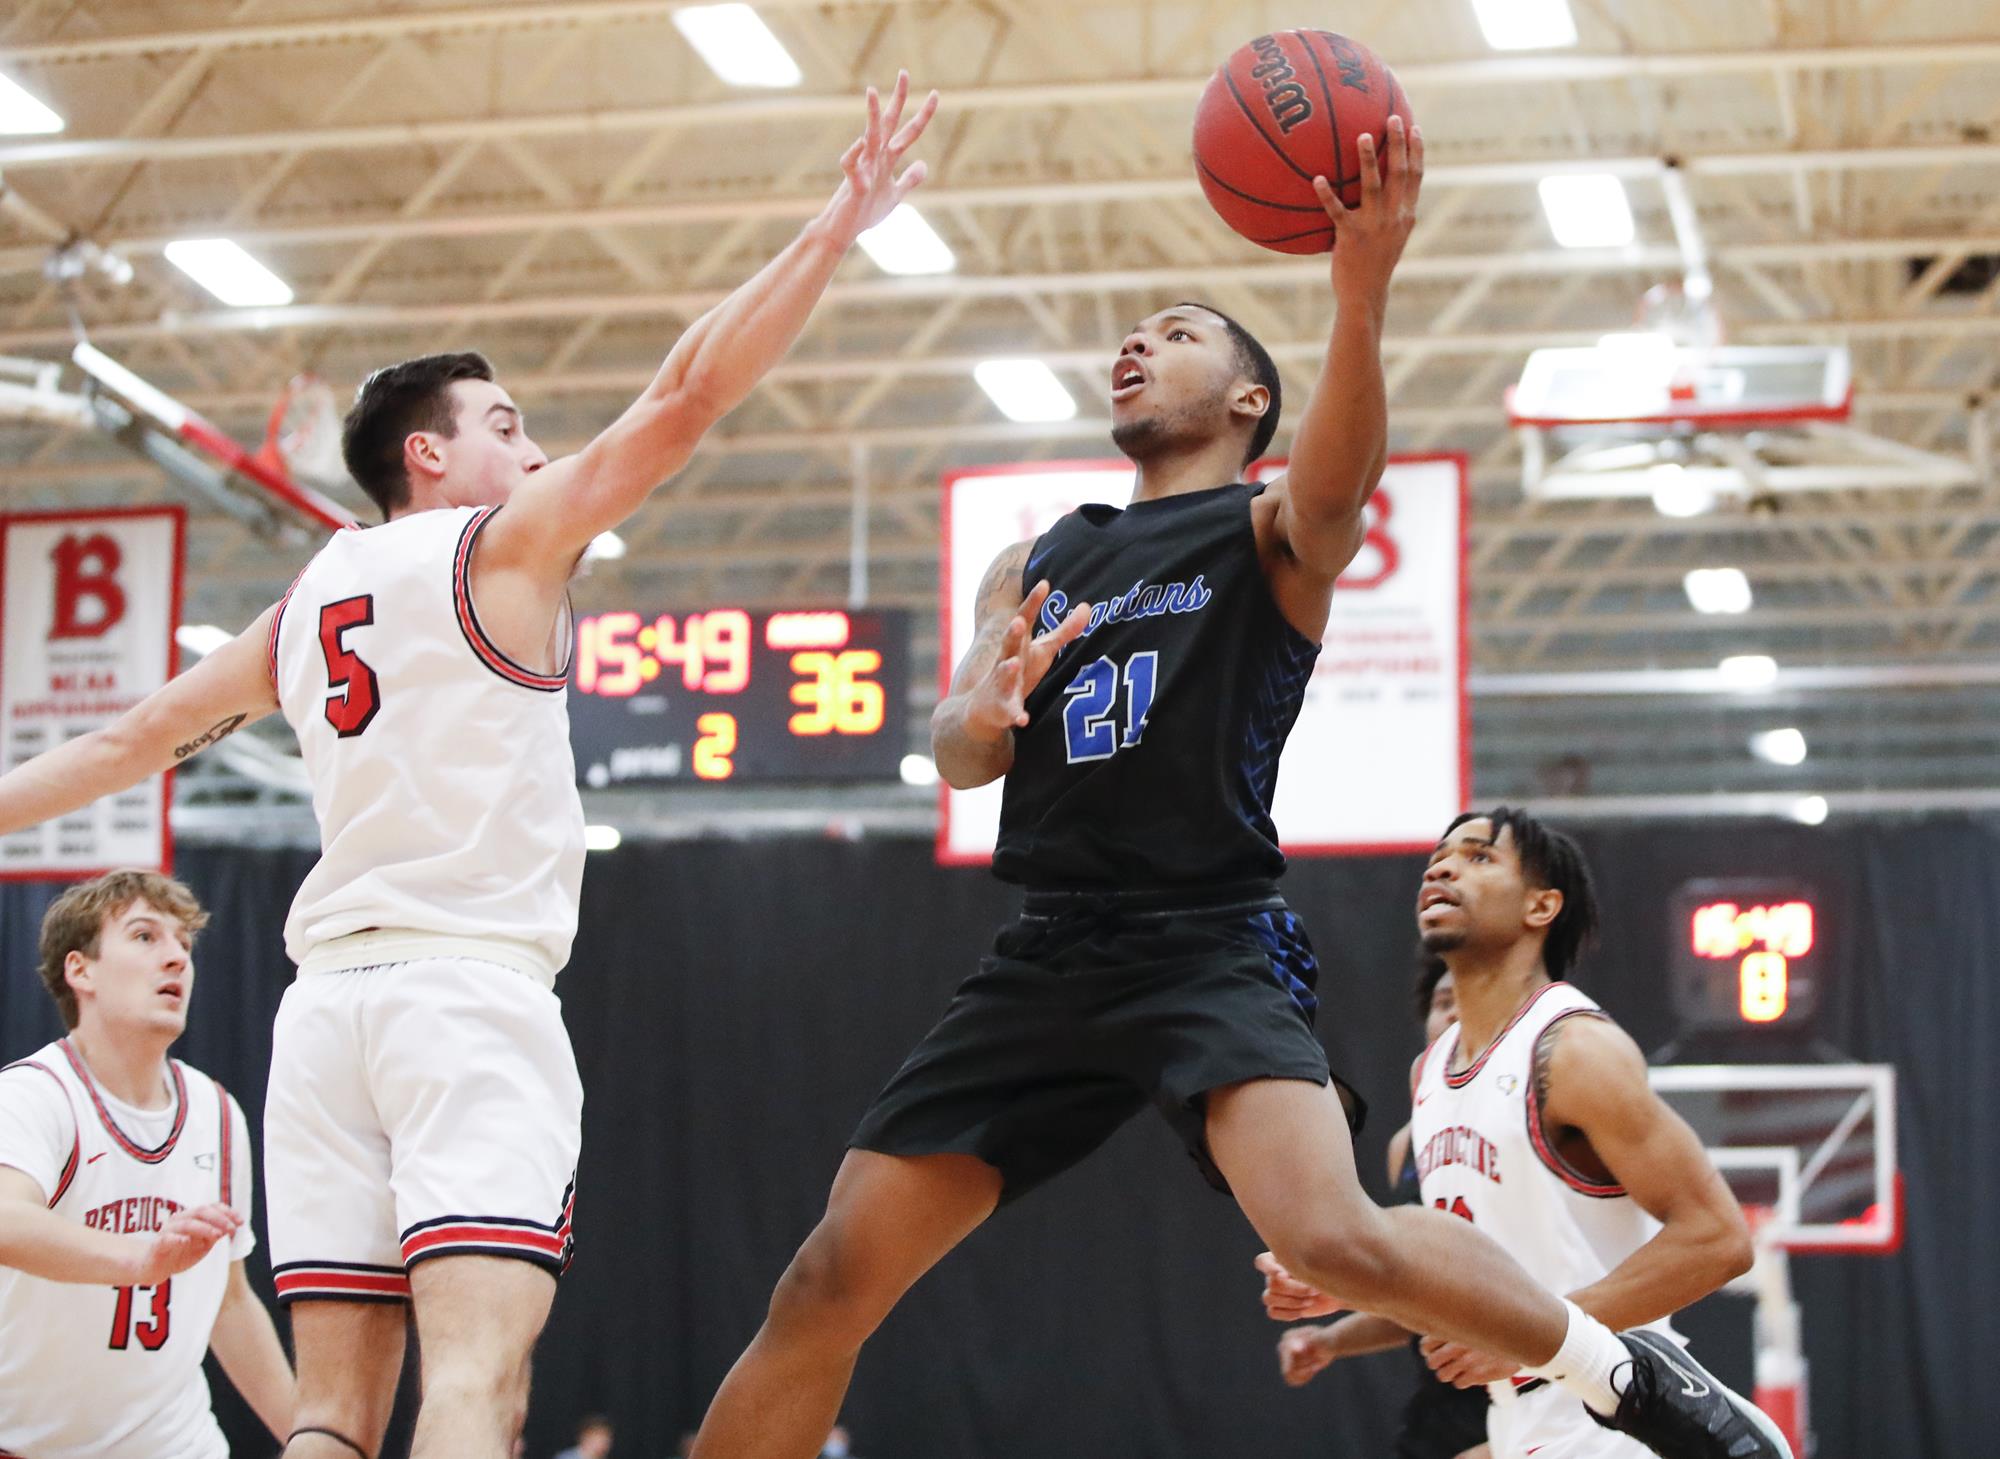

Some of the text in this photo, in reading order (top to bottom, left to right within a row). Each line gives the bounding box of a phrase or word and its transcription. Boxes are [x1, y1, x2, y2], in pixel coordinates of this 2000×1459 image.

[49, 533, 127, 640] B
[1037, 574, 1212, 655] Sartans
[319, 593, 380, 738] 5
[577, 609, 751, 696] 15:49
[788, 649, 884, 736] 36
[693, 712, 737, 780] 2
[1063, 650, 1158, 764] 21
[108, 1278, 172, 1351] 13
